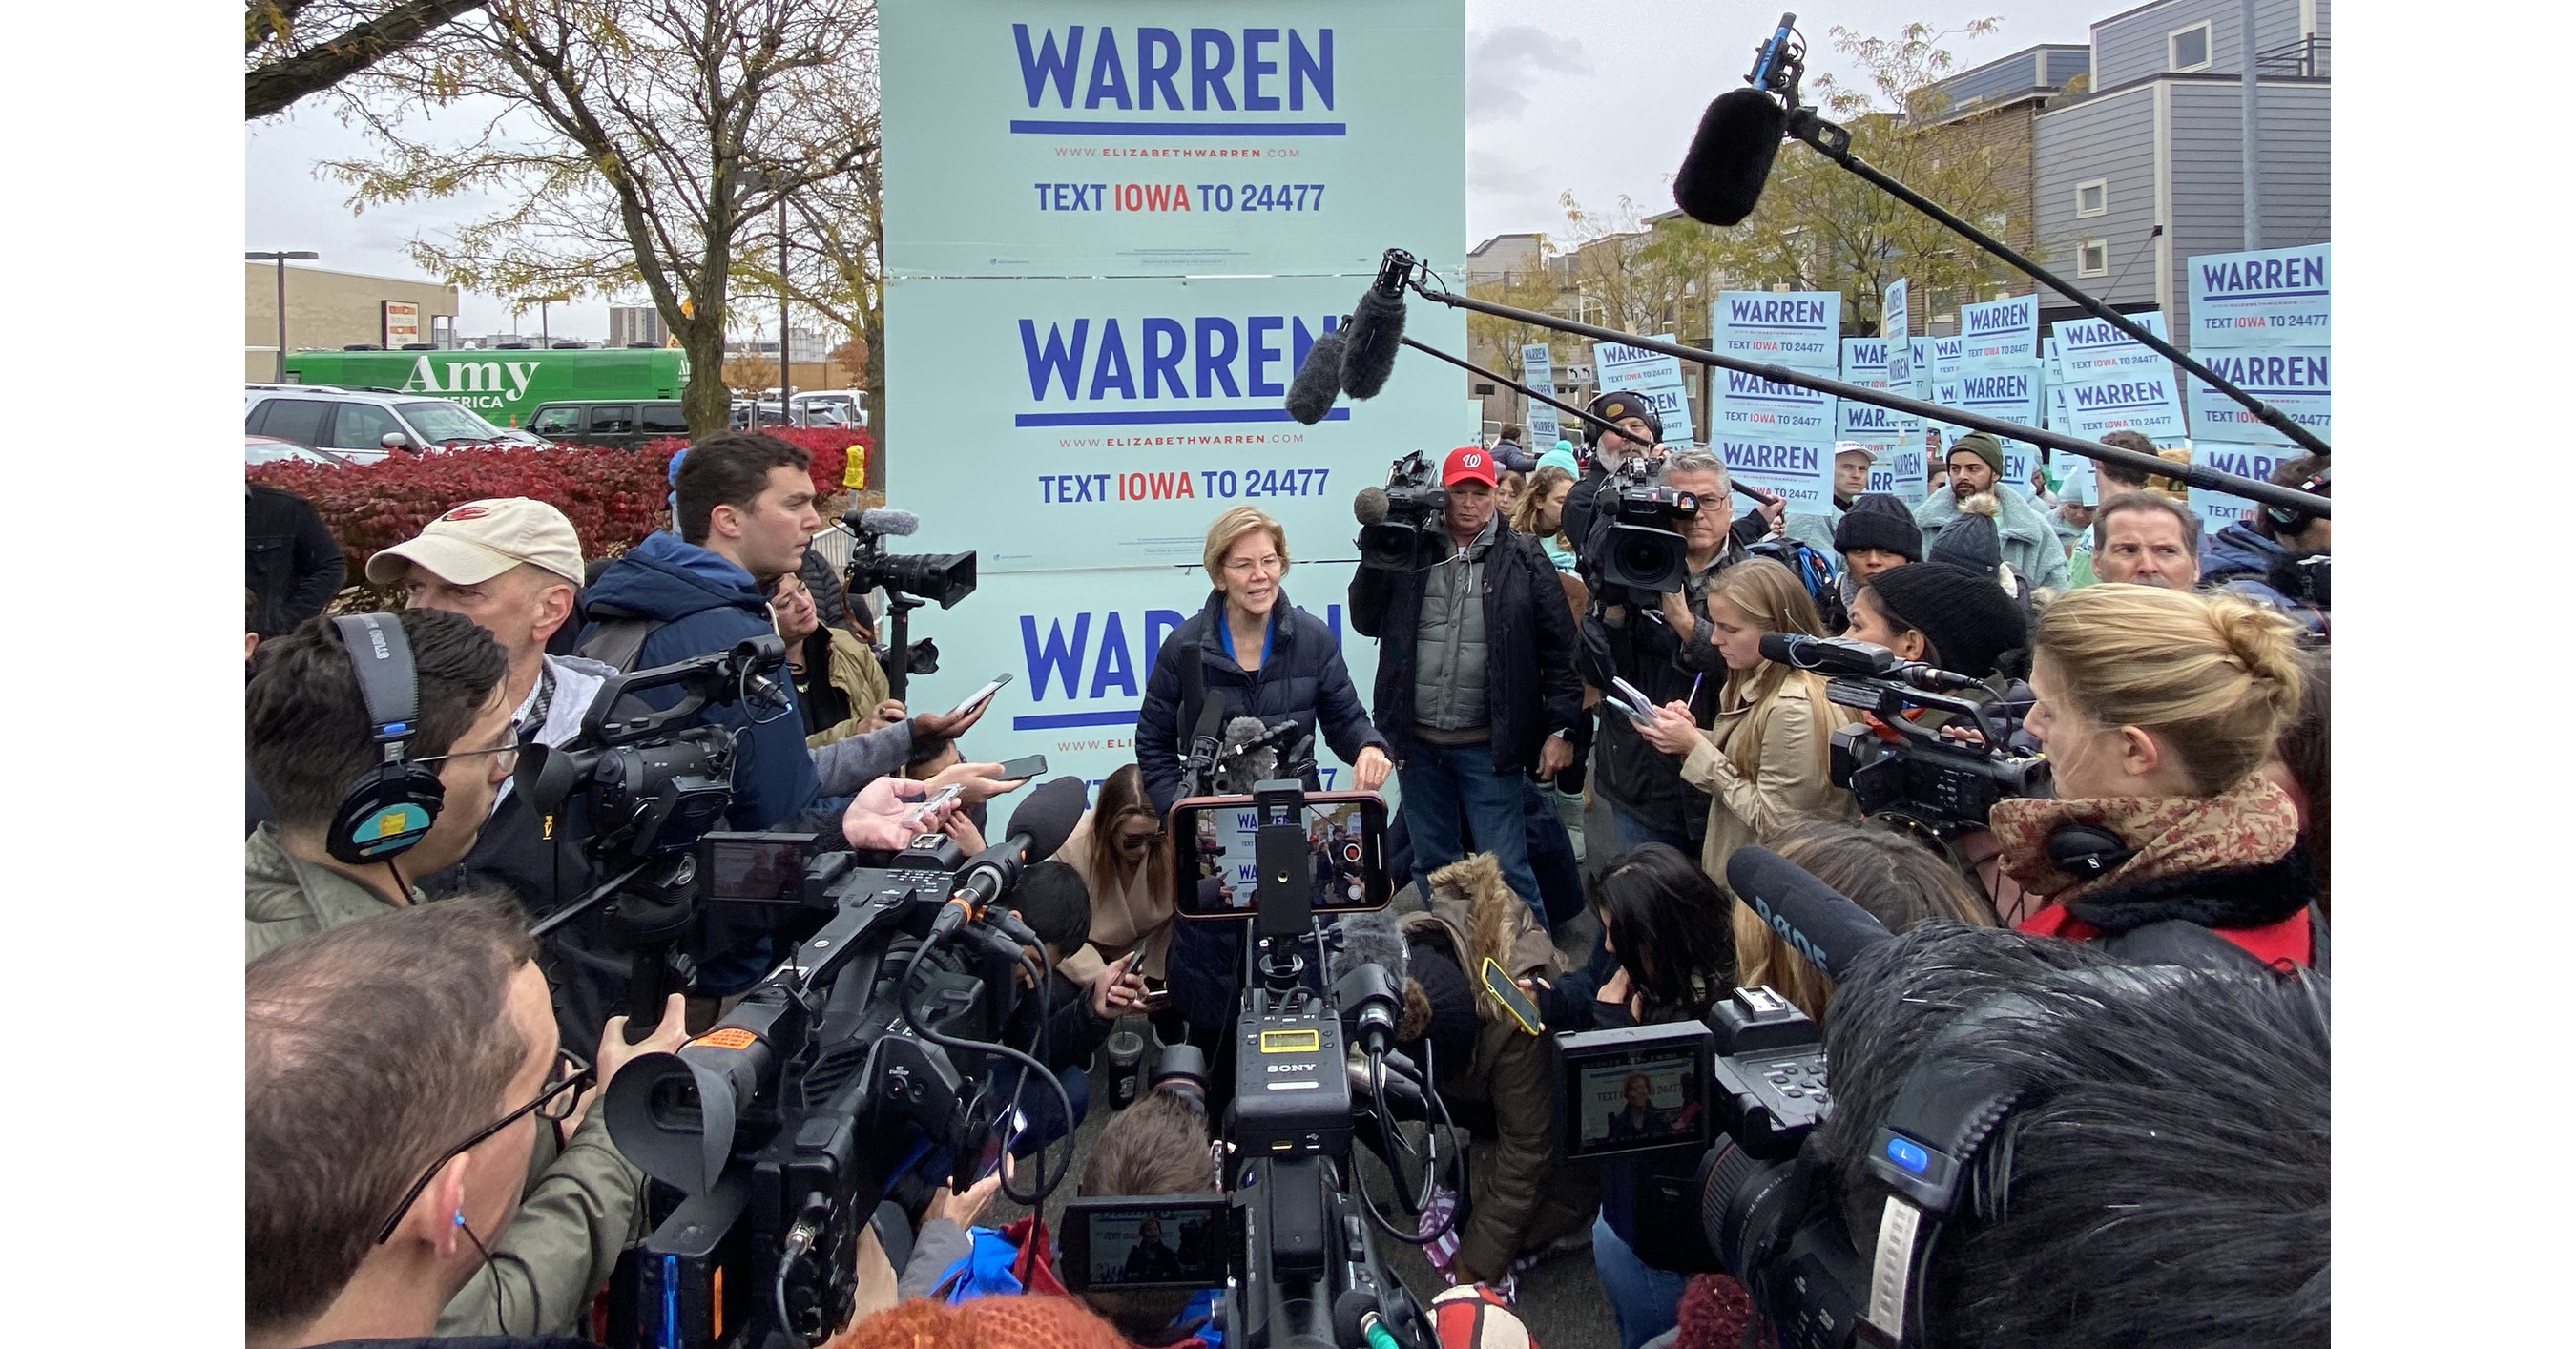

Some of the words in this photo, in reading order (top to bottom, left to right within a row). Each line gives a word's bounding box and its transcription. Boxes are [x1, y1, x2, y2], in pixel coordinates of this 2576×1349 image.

[1012, 23, 1334, 112] WARREN
[1055, 147, 1300, 158] WWW.ELIZABETHWARREN.COM
[1035, 183, 1107, 212] TEXT
[1114, 184, 1191, 212] IOWA
[1197, 184, 1233, 212] TO
[1241, 184, 1325, 212] 24477
[2203, 256, 2323, 292] WARREN
[1731, 300, 1825, 323] WARREN
[1970, 303, 2028, 331] WARREN
[2204, 318, 2233, 329] TEXT
[2234, 316, 2266, 328] IOWA
[2269, 316, 2284, 327] TO
[2288, 314, 2328, 326] 24477
[2066, 320, 2152, 345] WARR
[1728, 341, 1751, 349] TEXT
[1753, 342, 1777, 350] IOWA
[1780, 342, 1793, 351] TO
[1795, 343, 1824, 353] 24477
[1968, 349, 1984, 358] TEXT
[1984, 347, 2000, 356] IOWA
[2001, 346, 2009, 355] TO
[2010, 344, 2029, 354] 24477
[1018, 316, 1337, 401] WARREN
[2071, 361, 2091, 369] TEXT
[2093, 359, 2117, 367] IOWA
[2119, 357, 2131, 365] TO
[2132, 355, 2158, 364] 24477
[402, 355, 542, 401] Amy
[1643, 370, 1652, 379] TO
[1652, 368, 1672, 377] 24477
[1964, 375, 2027, 399] WARREN
[2074, 381, 2164, 406] WARREN
[1725, 411, 1748, 422] TEXT
[1750, 413, 1775, 423] IOWA
[1778, 415, 1790, 425] TO
[1792, 416, 1821, 426] 24477
[2081, 422, 2104, 430] TEXT
[2105, 420, 2129, 428] IOWA
[2129, 418, 2141, 426] TO
[2144, 416, 2171, 425] 24477
[2206, 411, 2233, 422] TEXT
[2236, 411, 2263, 424] IOW
[1059, 434, 1304, 447] WWW.ELIZABETHWARREN.COM
[1723, 443, 1818, 471] WARREN
[1039, 473, 1110, 503] TEXT
[1119, 471, 1195, 501] IOWA
[1201, 470, 1236, 499] TO
[1245, 468, 1330, 498] 24477
[1789, 489, 1818, 500] 24477
[2208, 505, 2237, 518] TEXT
[1267, 1064, 1316, 1072] SONY
[1901, 1148, 1907, 1159] L
